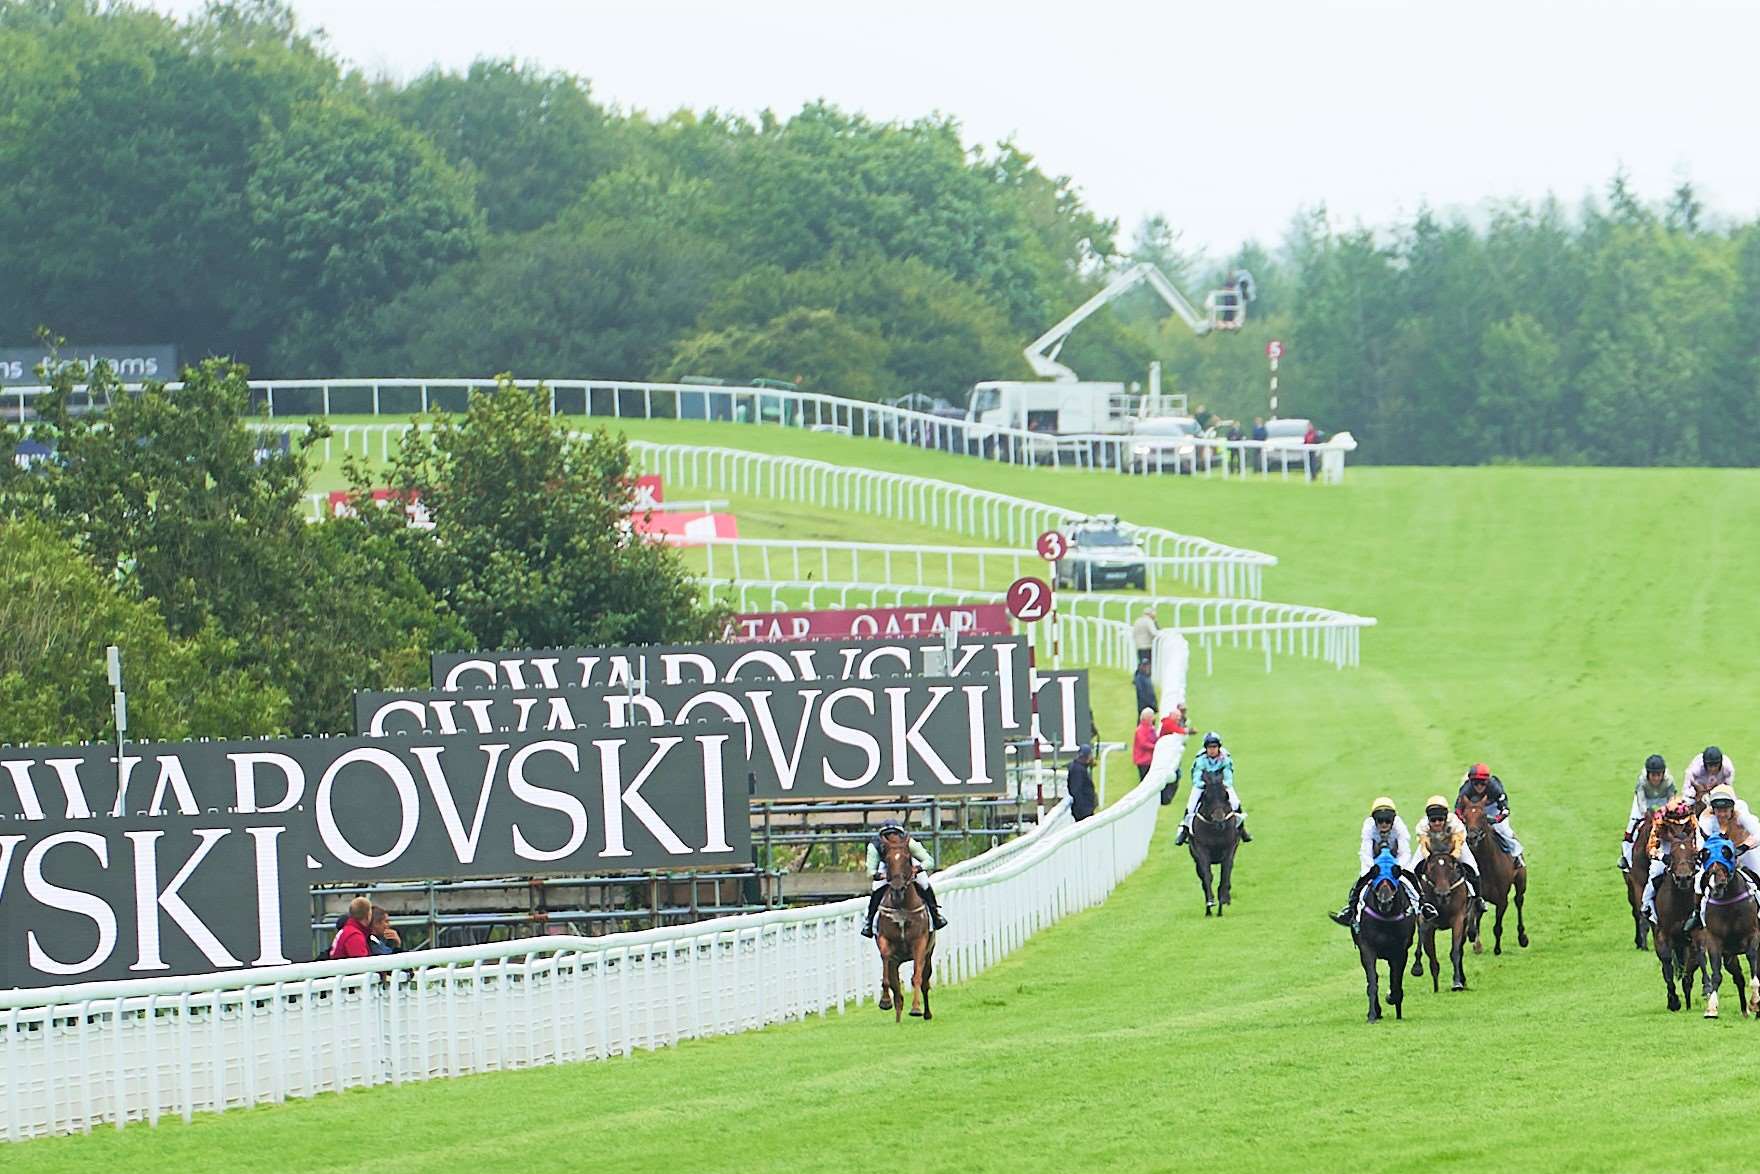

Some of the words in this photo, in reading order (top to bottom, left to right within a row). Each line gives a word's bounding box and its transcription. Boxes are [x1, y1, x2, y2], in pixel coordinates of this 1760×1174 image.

[1046, 533, 1062, 559] 3
[1018, 582, 1042, 618] 2
[710, 617, 810, 642] ATAR
[0, 826, 292, 975] SKI
